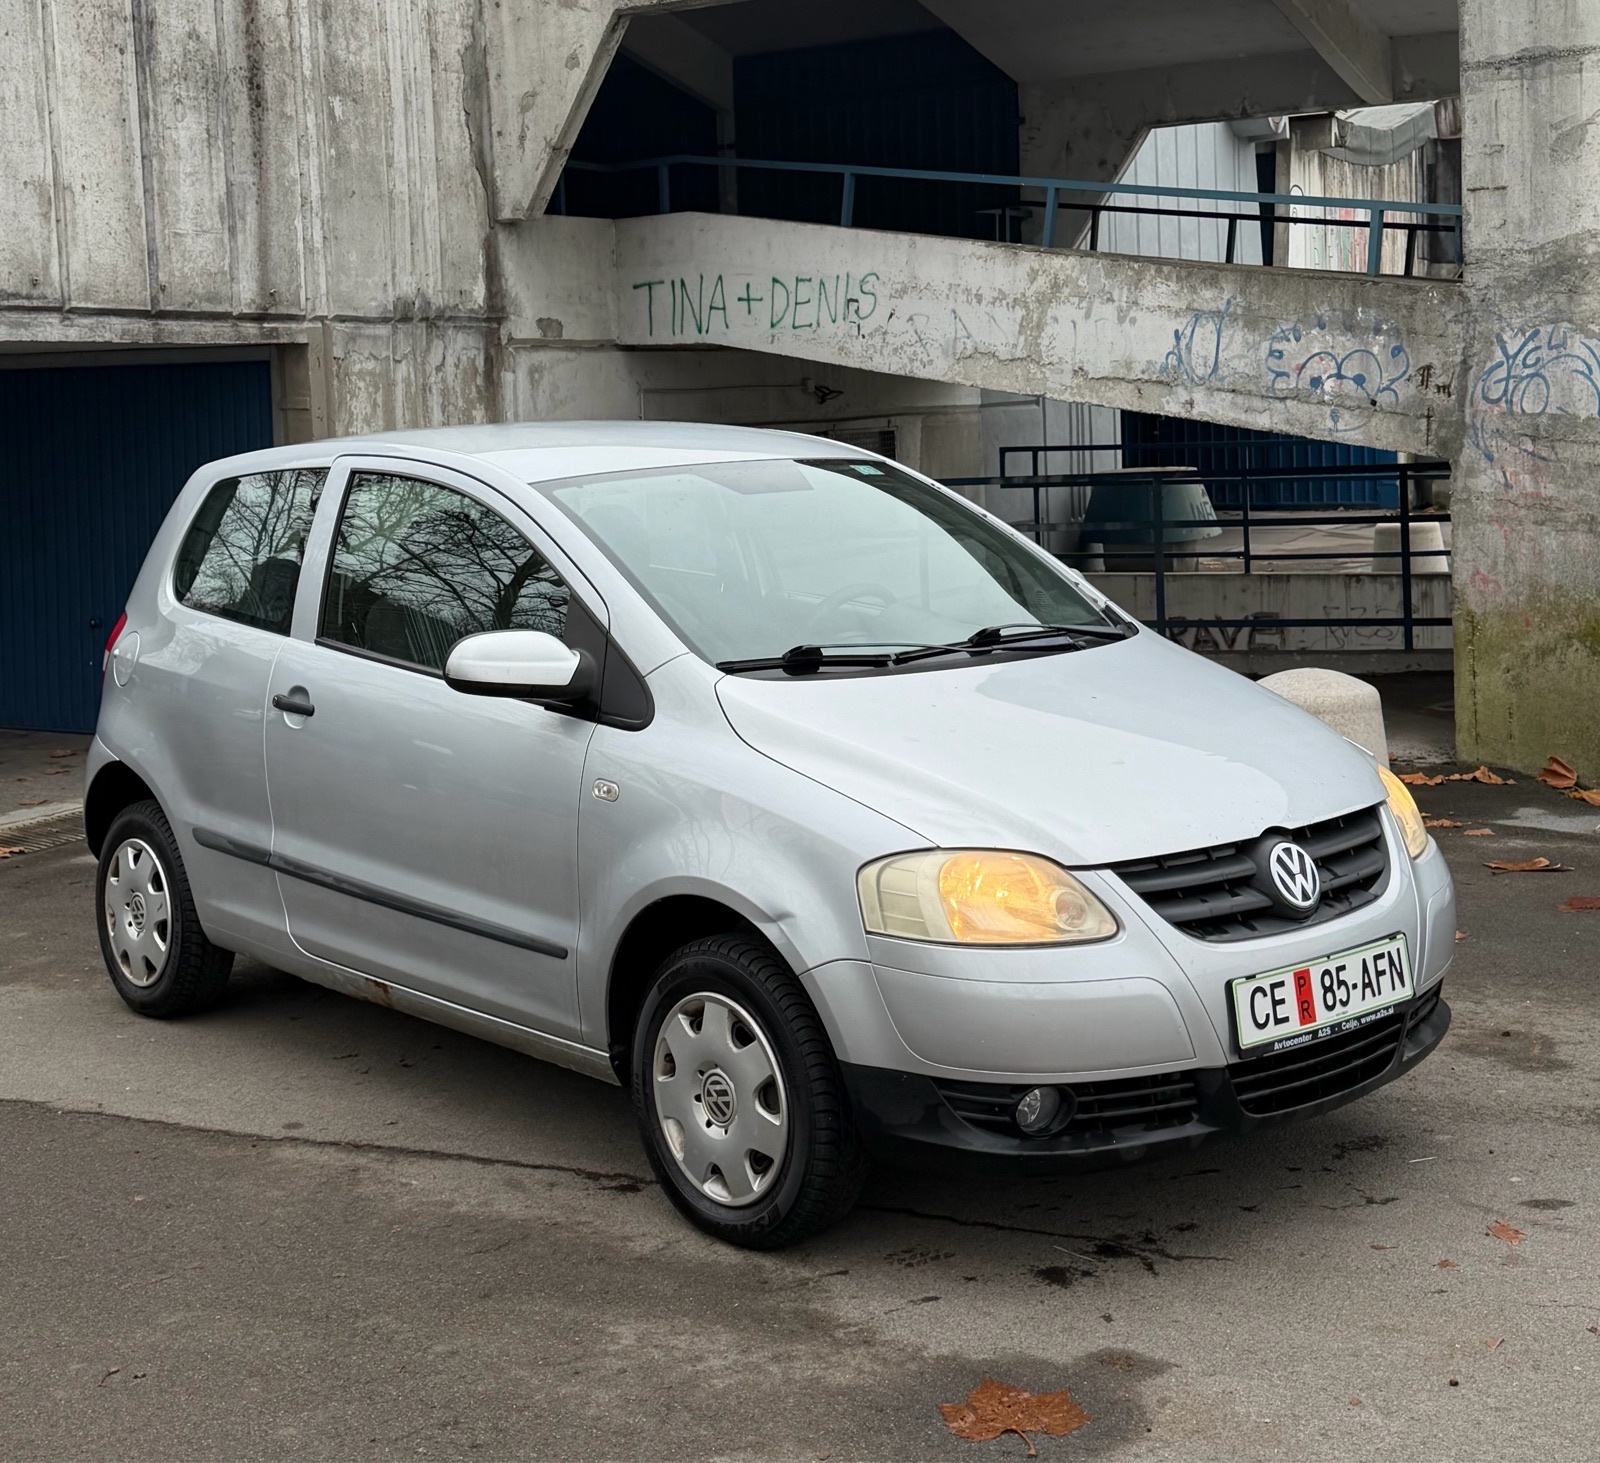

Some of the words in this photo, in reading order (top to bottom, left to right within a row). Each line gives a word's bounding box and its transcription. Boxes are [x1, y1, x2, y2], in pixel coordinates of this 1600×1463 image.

[1271, 844, 1319, 907] VW
[1250, 980, 1290, 1030] CE
[1320, 947, 1406, 1012] 85-AFN
[1317, 1027, 1332, 1038] A2S
